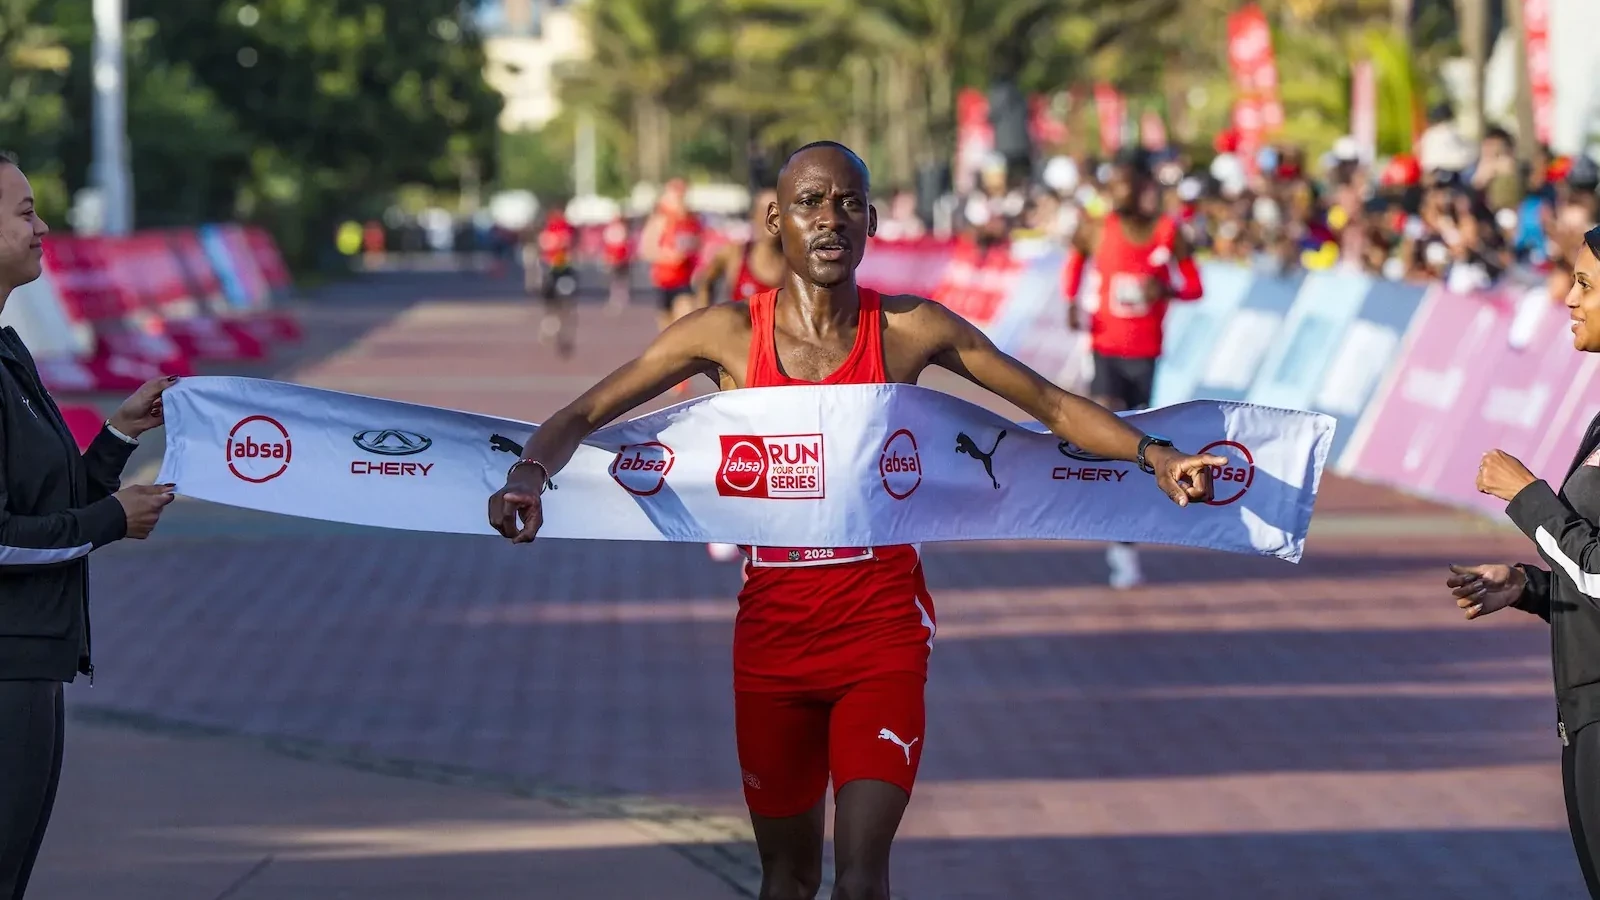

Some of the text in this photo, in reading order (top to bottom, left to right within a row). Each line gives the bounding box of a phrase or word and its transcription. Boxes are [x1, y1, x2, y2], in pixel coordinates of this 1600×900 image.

[234, 436, 284, 459] absa
[768, 442, 819, 465] RUN
[350, 461, 434, 477] CHERY
[619, 451, 667, 472] absa
[728, 456, 761, 472] absa
[885, 450, 917, 473] absa
[772, 466, 816, 475] YOUR CITY
[1052, 467, 1129, 482] CHERY
[1210, 464, 1247, 483] bsa
[770, 475, 816, 489] SERIES
[804, 549, 835, 560] 2025
